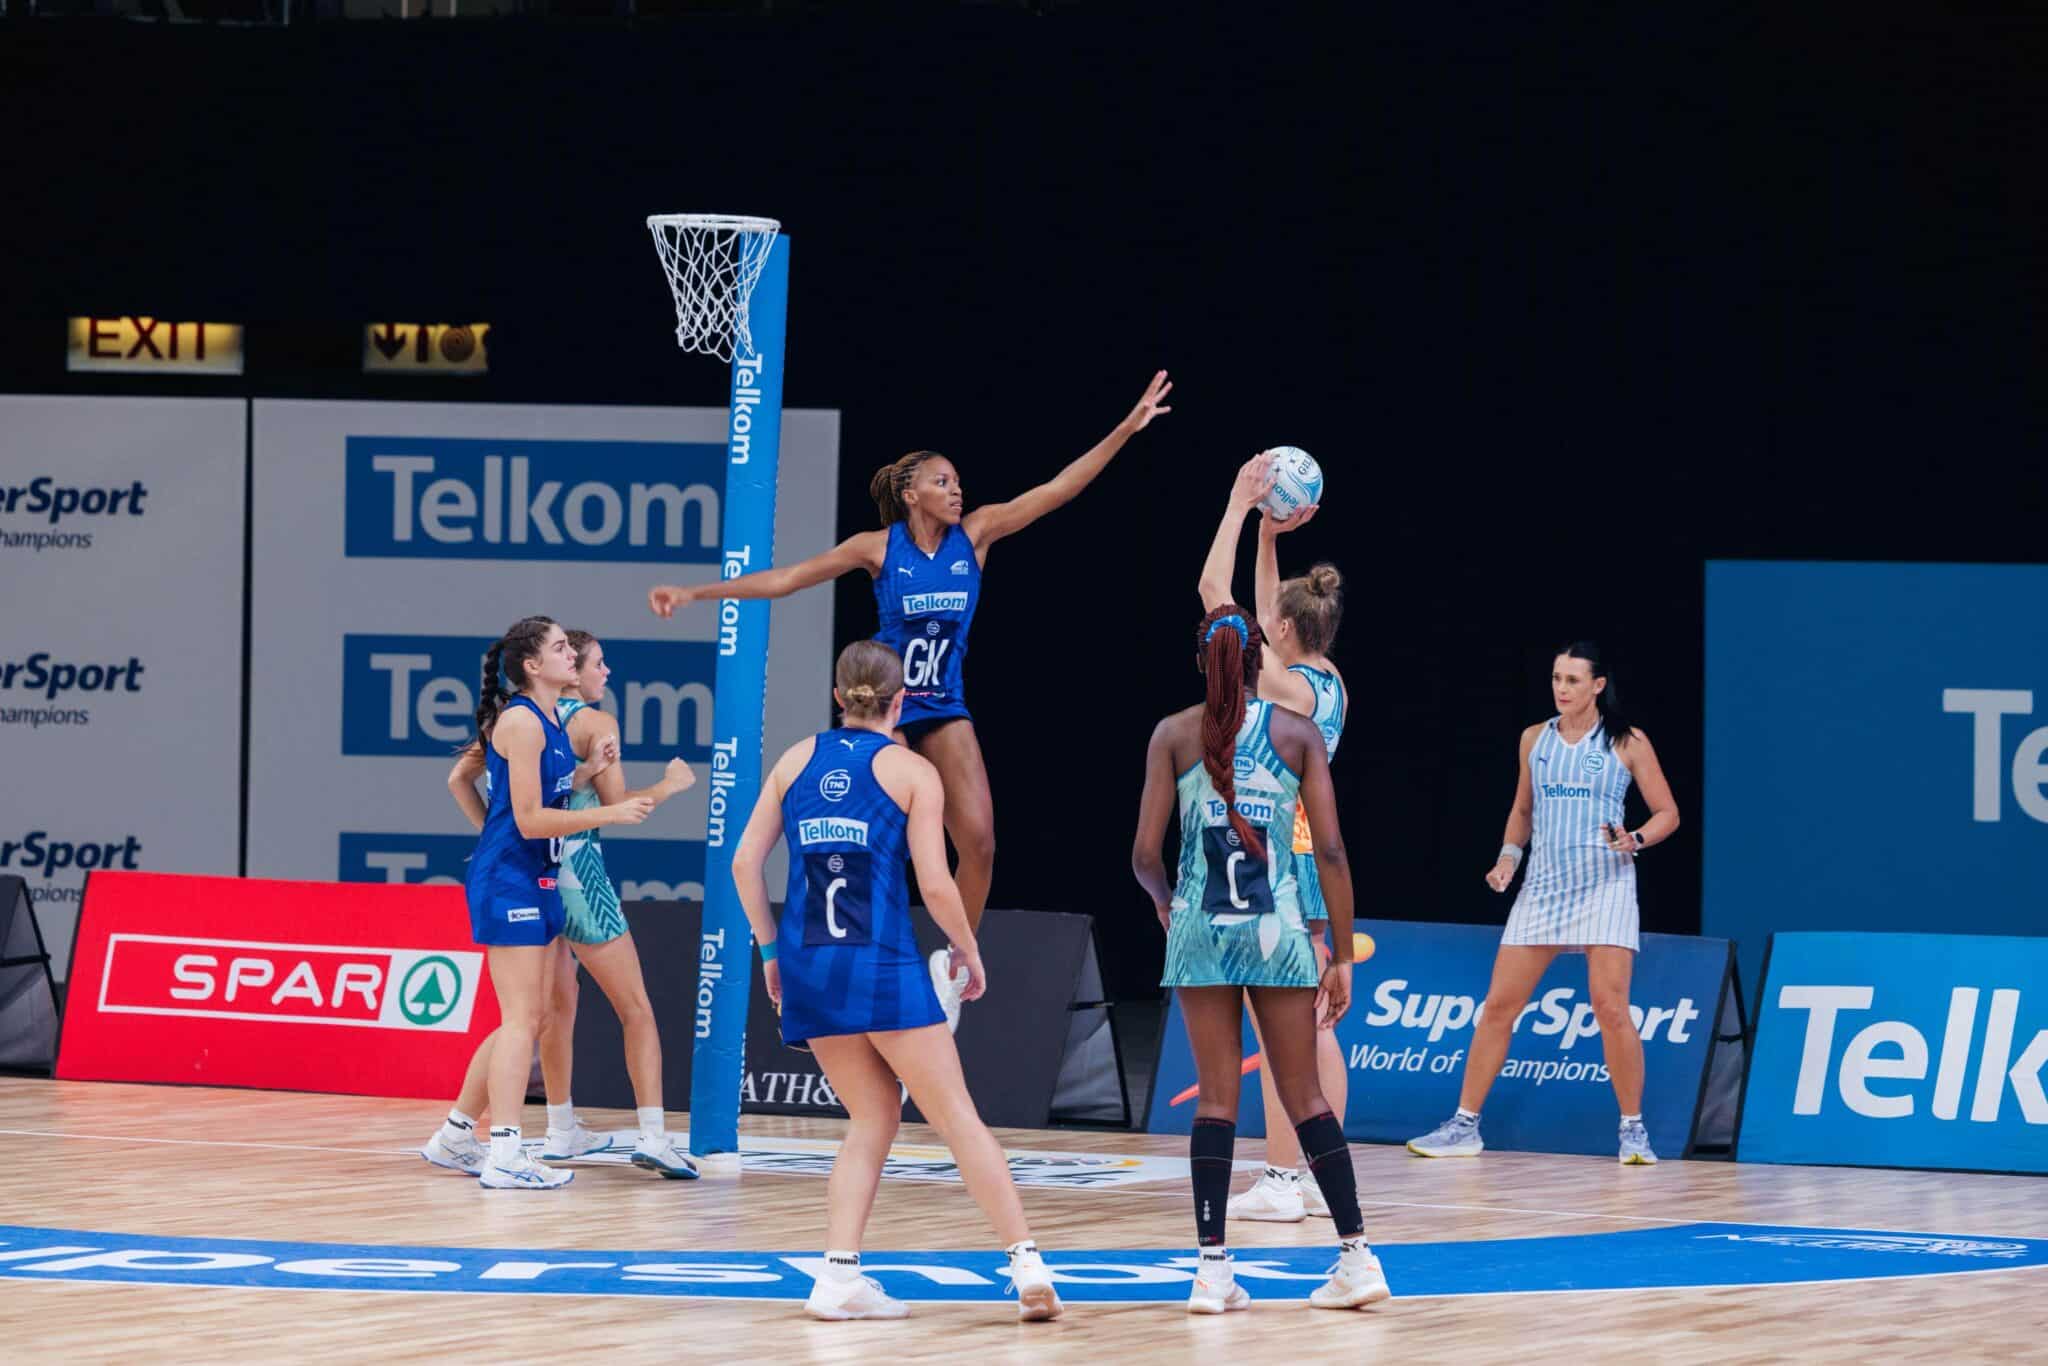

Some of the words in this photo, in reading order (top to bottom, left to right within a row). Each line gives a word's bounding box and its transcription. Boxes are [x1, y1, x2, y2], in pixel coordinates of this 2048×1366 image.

[731, 353, 762, 465] Telkom
[0, 477, 148, 524] rSport
[373, 455, 719, 548] Telkom
[905, 595, 966, 612] Telkom
[0, 653, 144, 700] rSport
[904, 638, 949, 687] GK
[708, 737, 737, 847] Telkom
[1543, 785, 1590, 798] Telkom
[802, 820, 864, 842] Telkom
[1227, 851, 1249, 909] C
[826, 878, 847, 938] C
[170, 954, 382, 1010] SPAR
[695, 929, 724, 1038] Telkom
[1350, 1044, 1422, 1072] World
[1430, 1048, 1465, 1073] of
